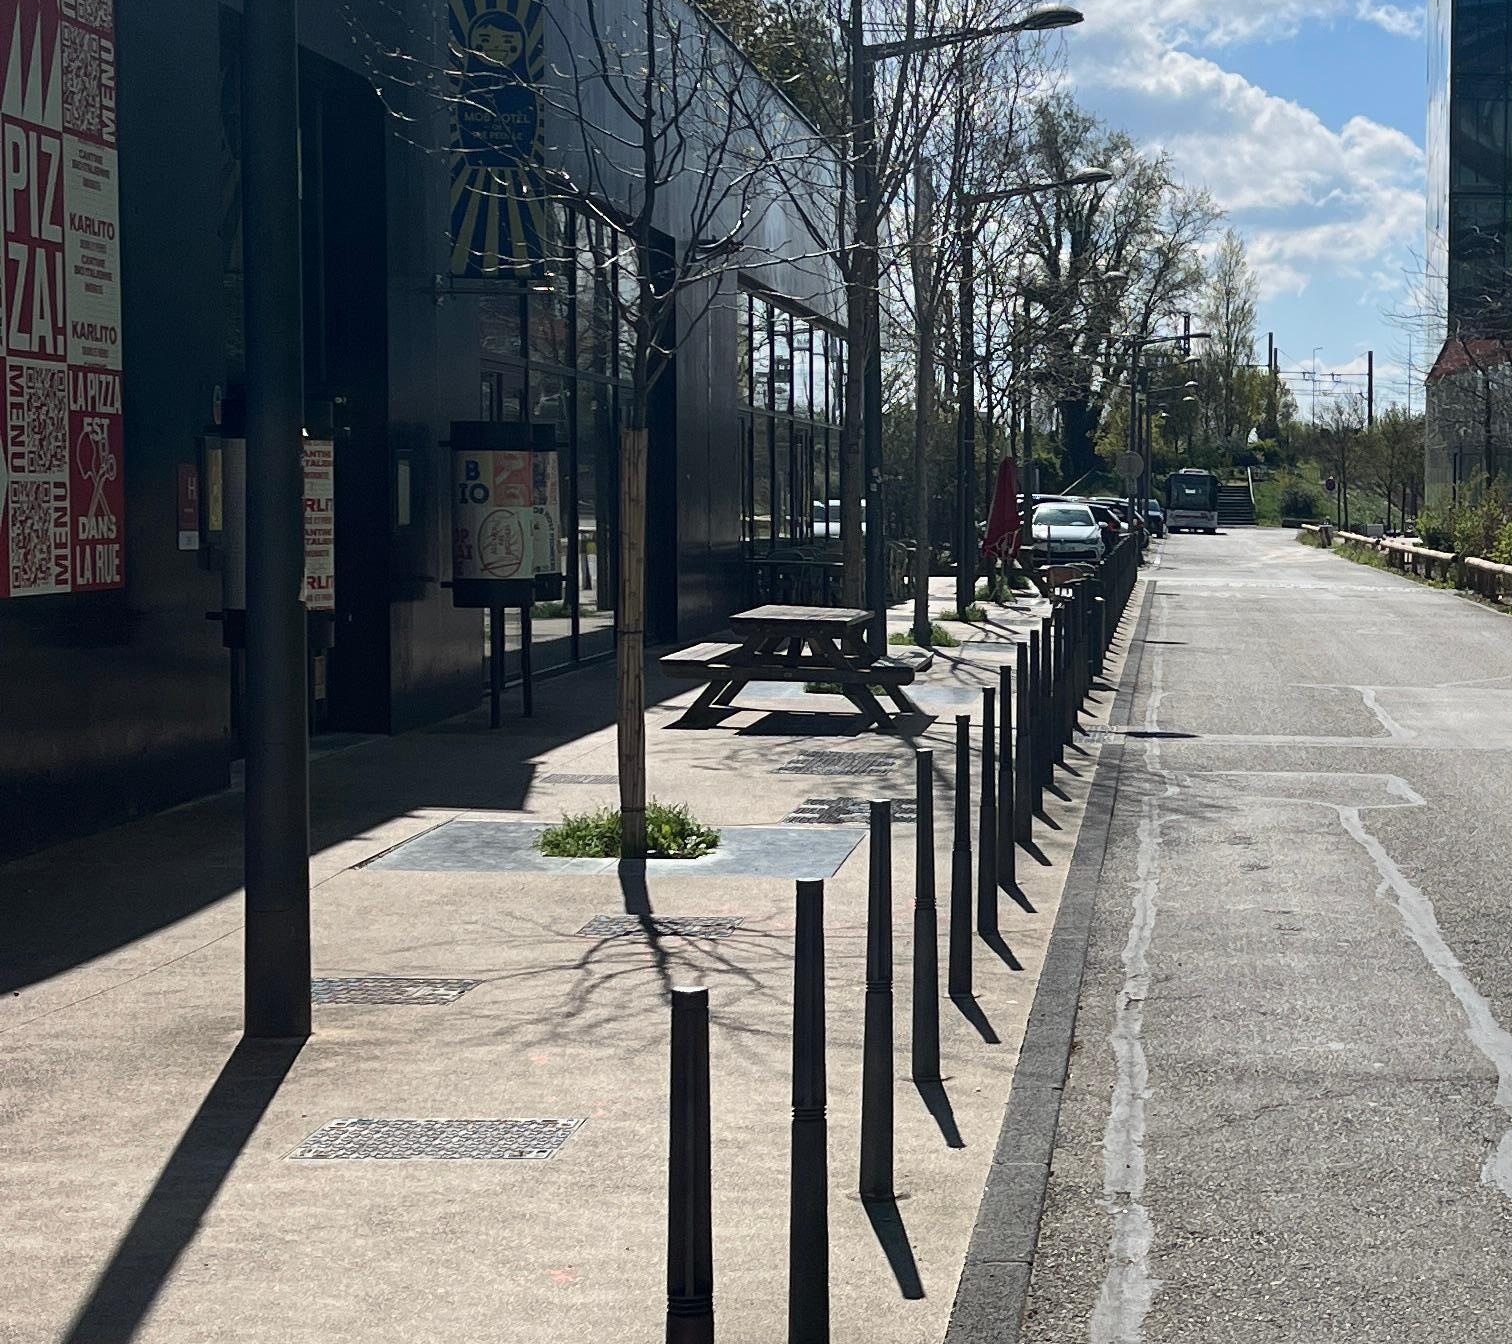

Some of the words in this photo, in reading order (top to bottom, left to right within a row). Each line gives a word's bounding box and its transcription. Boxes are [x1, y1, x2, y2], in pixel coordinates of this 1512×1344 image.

[100, 38, 117, 143] MENU
[5, 122, 63, 244] PIZ
[69, 212, 116, 240] KARLITO
[8, 241, 65, 355] ZA!
[71, 320, 118, 345] KARLITO
[70, 370, 86, 412] LA
[87, 372, 122, 415] PIZZA
[8, 364, 25, 474] MENU
[83, 416, 110, 441] EST
[53, 481, 70, 586] MENU
[78, 514, 117, 541] DANS
[76, 544, 93, 586] LA
[95, 544, 120, 584] RUE
